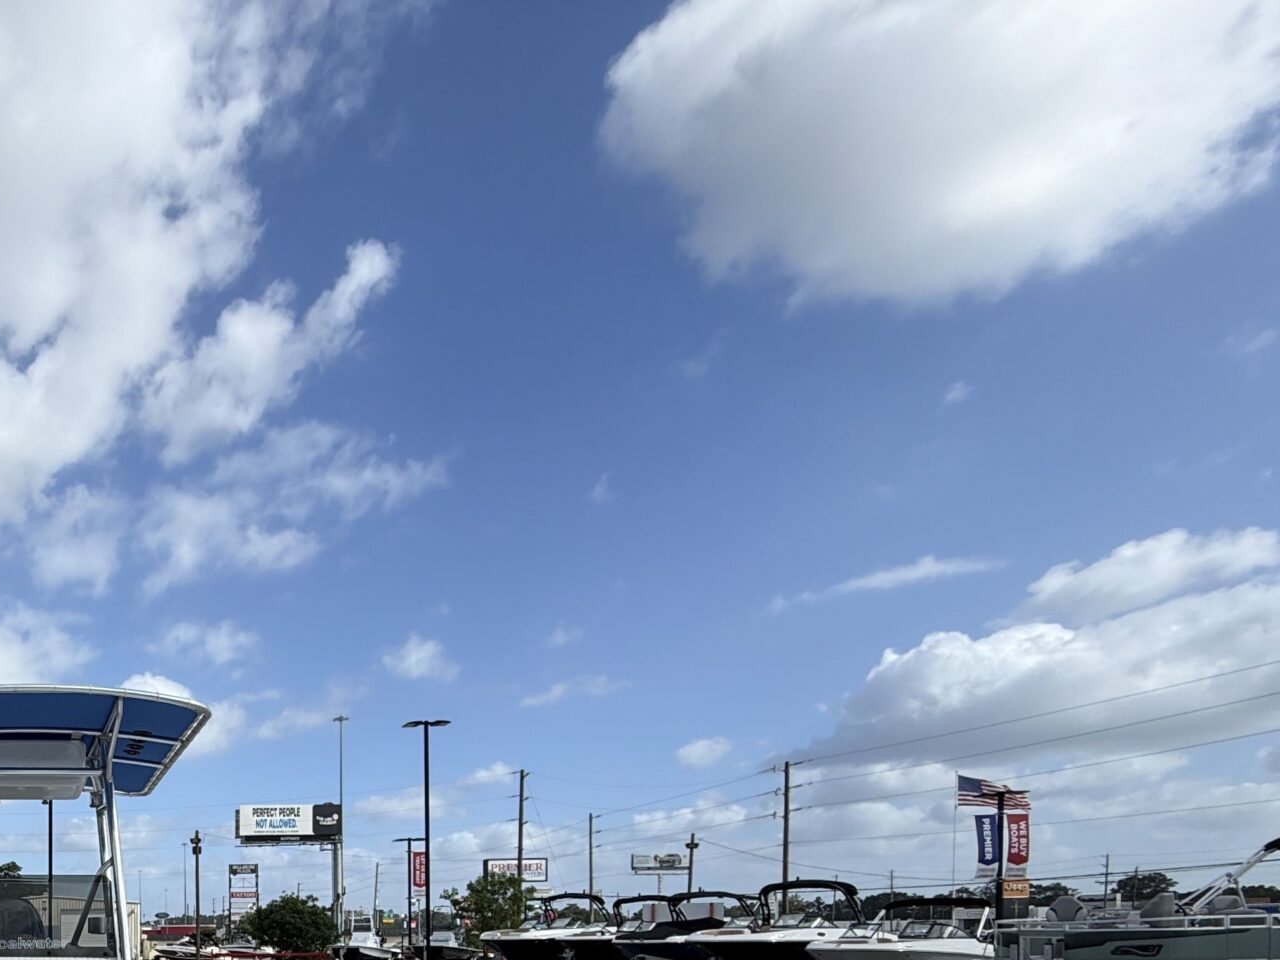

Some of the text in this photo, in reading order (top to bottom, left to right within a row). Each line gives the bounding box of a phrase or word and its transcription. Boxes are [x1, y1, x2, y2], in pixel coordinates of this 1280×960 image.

[252, 807, 301, 818] PERFECT PEOPLE
[255, 818, 298, 829] NOT ALLOWED.
[982, 818, 993, 860] PREMIER
[1010, 823, 1019, 854] BOATS
[1019, 821, 1027, 857] WE BUY
